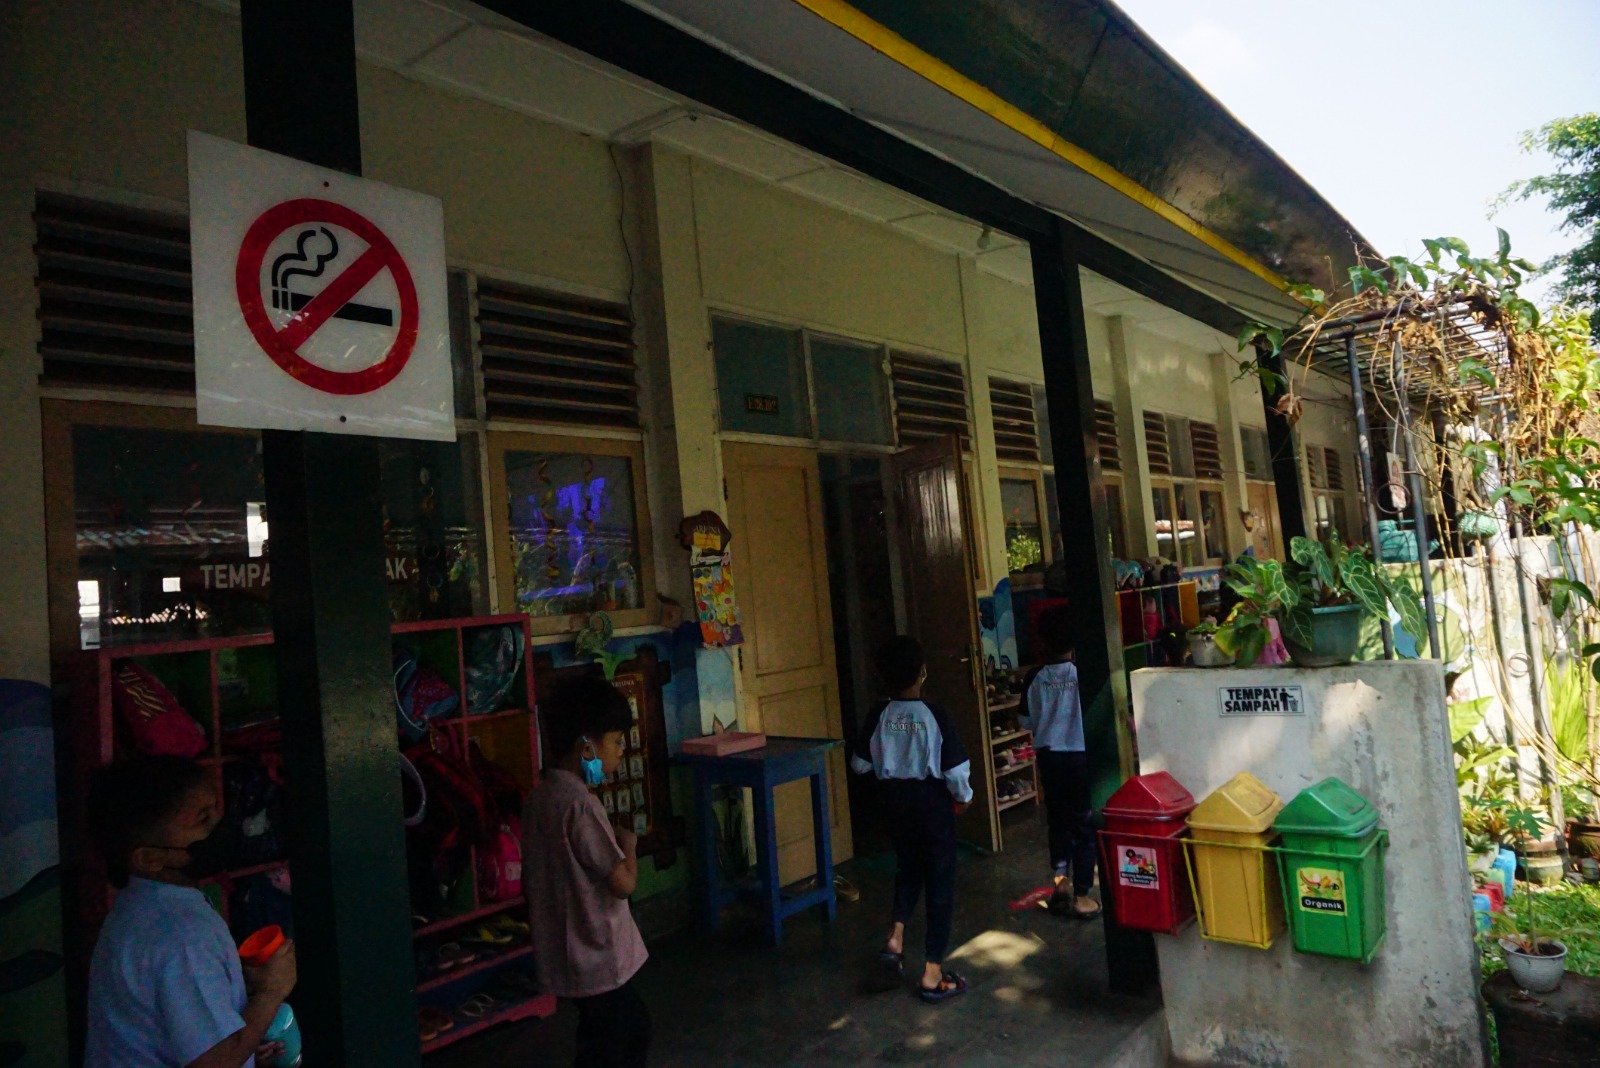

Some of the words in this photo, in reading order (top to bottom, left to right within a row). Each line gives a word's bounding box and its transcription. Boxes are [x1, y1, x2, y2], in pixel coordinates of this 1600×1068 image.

[1227, 688, 1278, 700] TEMPAT
[1225, 700, 1280, 712] SAMPAH
[1304, 898, 1342, 910] Organik
